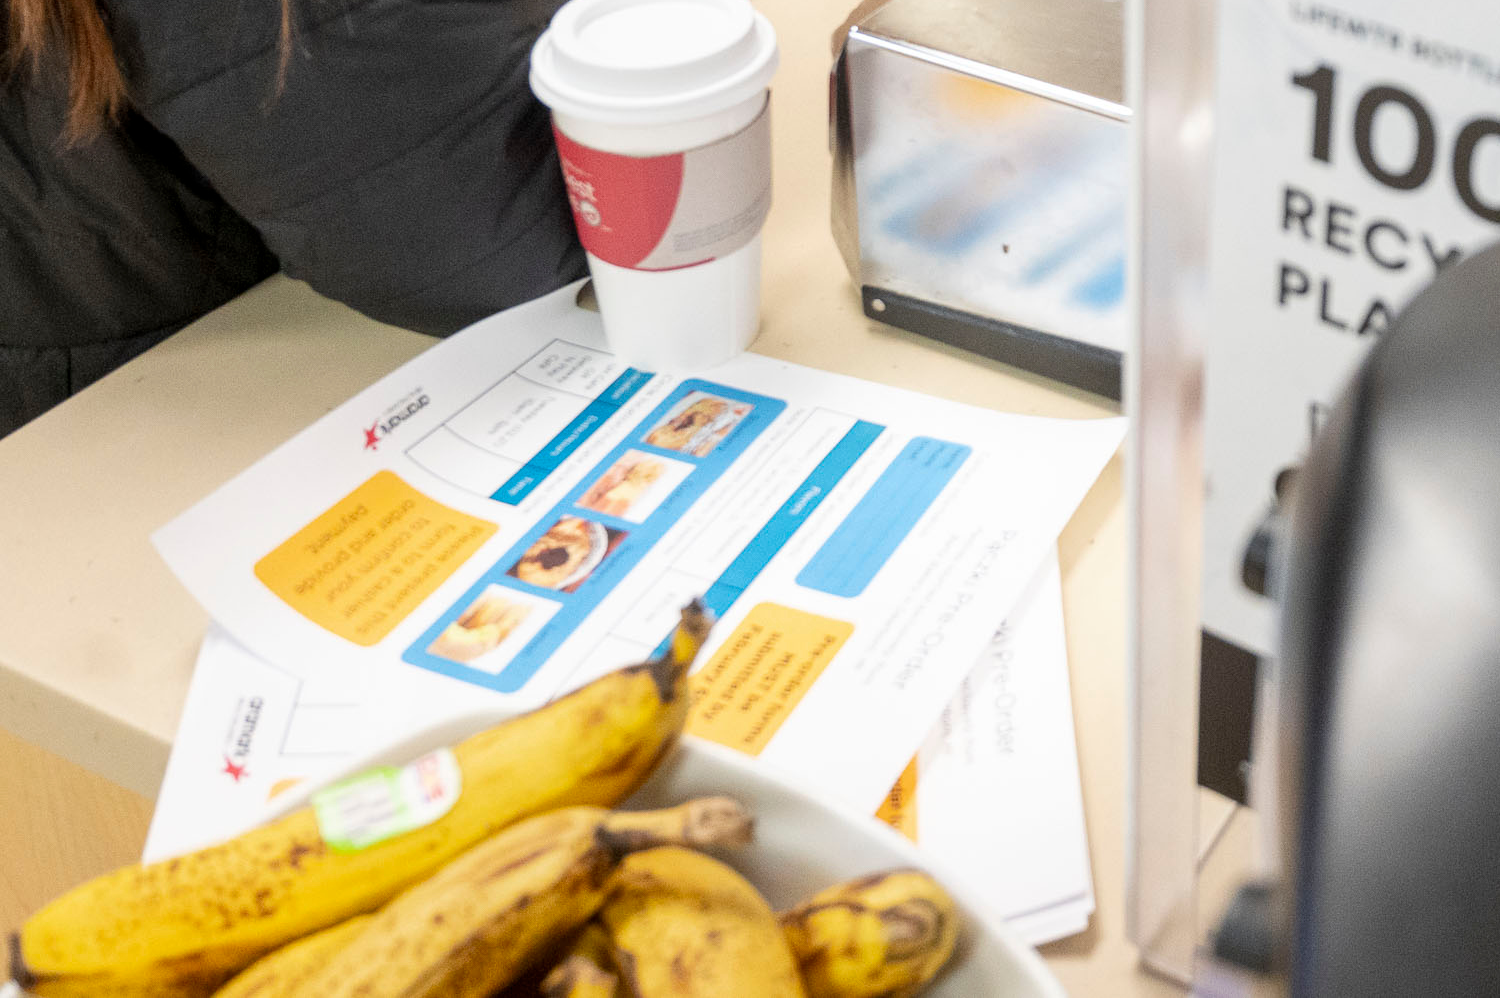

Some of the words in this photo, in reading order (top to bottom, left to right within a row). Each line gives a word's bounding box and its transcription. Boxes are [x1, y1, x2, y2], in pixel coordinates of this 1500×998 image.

[1279, 183, 1463, 277] RECY
[1277, 263, 1396, 338] PLA
[304, 504, 369, 555] payment
[380, 499, 416, 530] order
[408, 517, 431, 531] to
[350, 529, 377, 552] and
[357, 530, 412, 574] confirm
[420, 523, 456, 551] form
[294, 550, 350, 596] provide
[402, 551, 423, 566] to
[326, 573, 360, 602] your
[344, 575, 391, 618] cashier
[894, 592, 974, 691] Pre-Order
[721, 631, 782, 701] submitted
[758, 651, 795, 691] MUST
[703, 701, 726, 722] by
[741, 693, 761, 713] be
